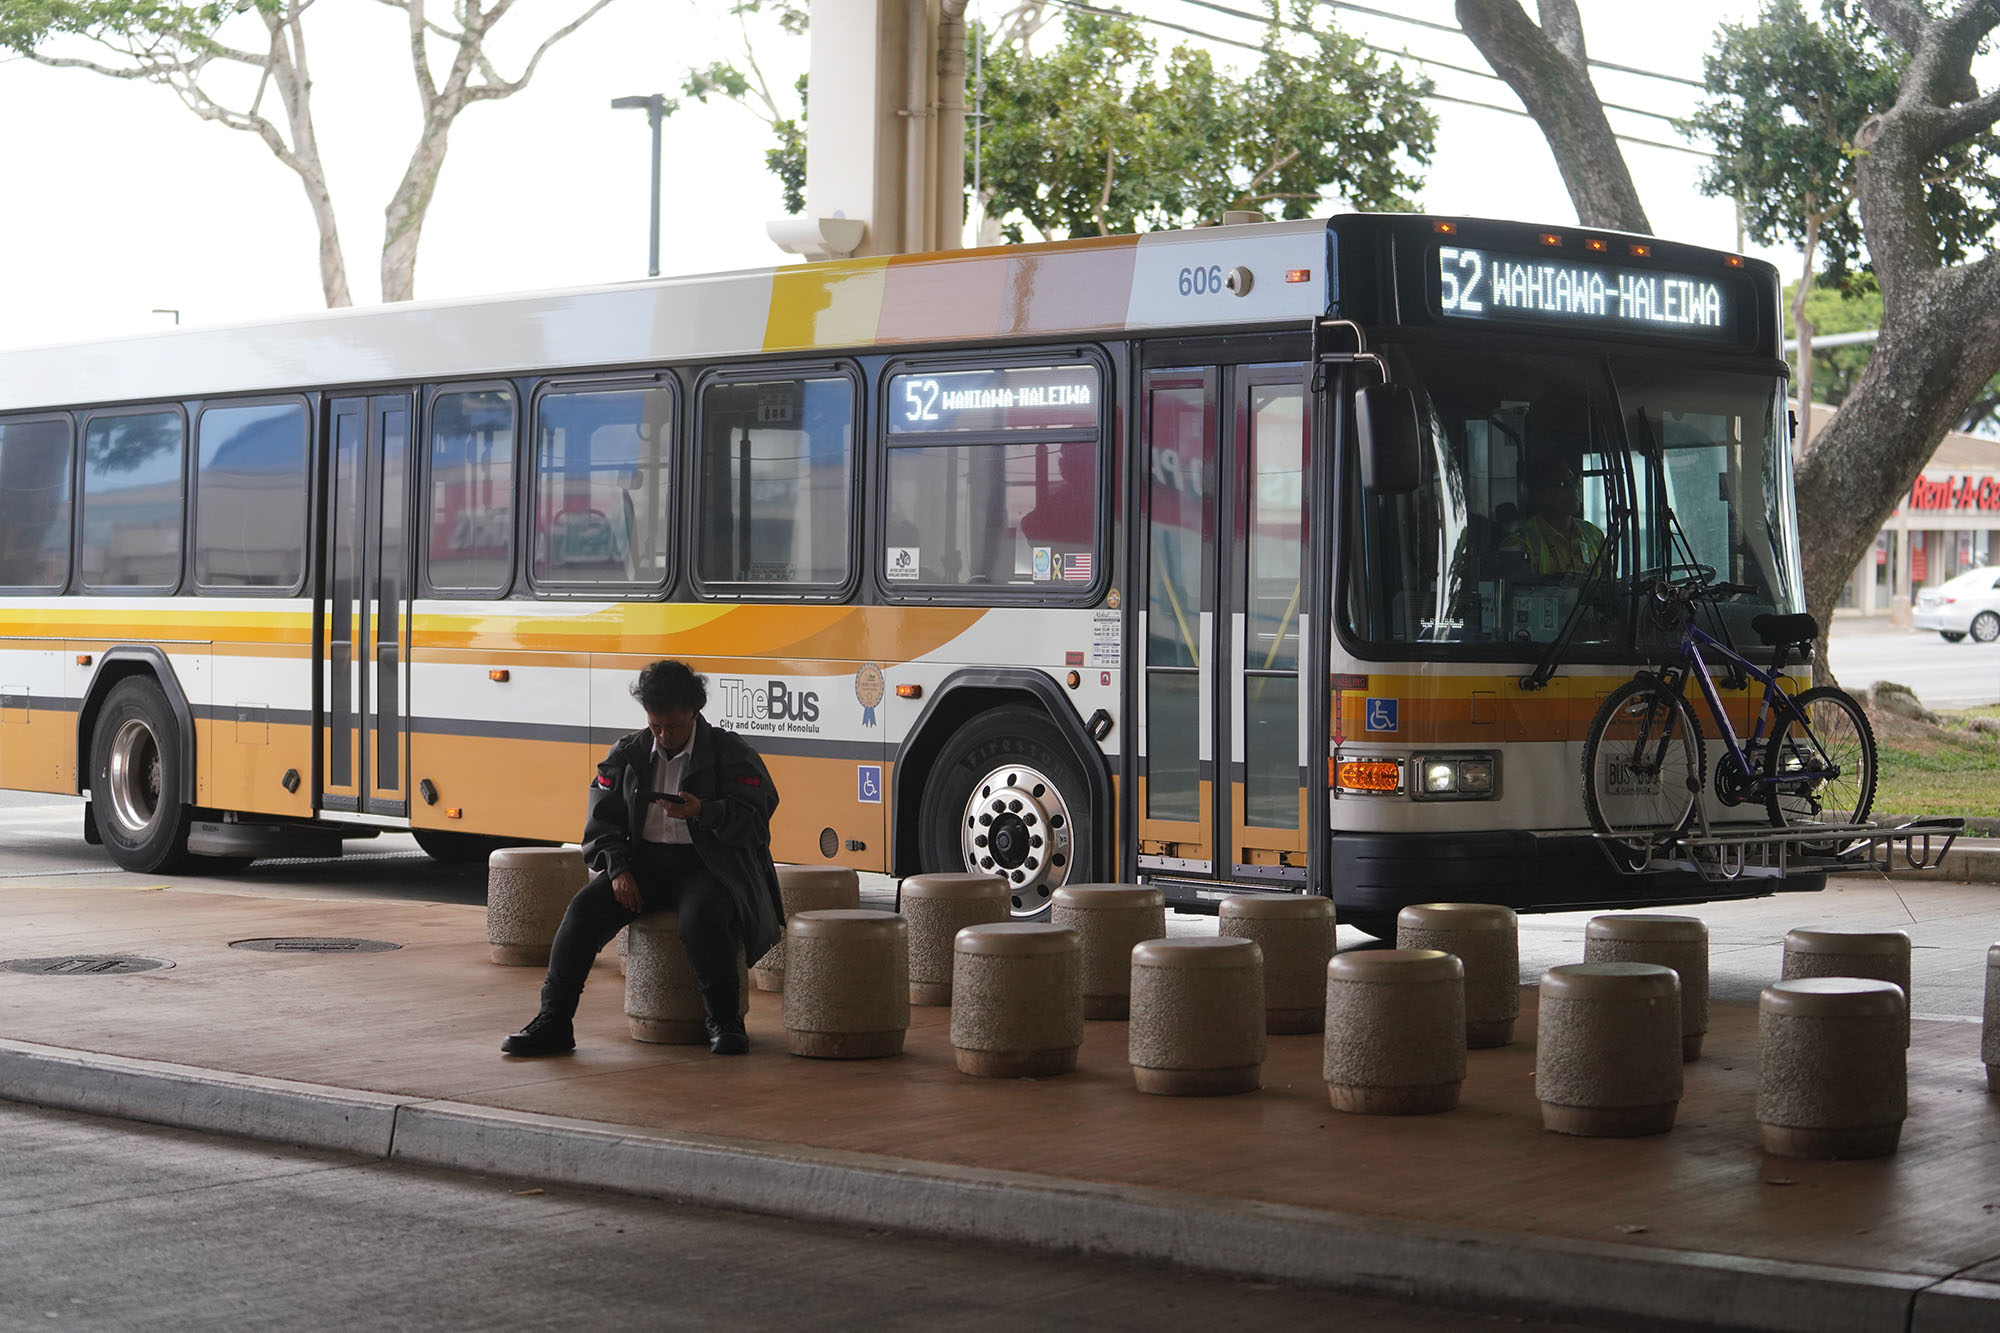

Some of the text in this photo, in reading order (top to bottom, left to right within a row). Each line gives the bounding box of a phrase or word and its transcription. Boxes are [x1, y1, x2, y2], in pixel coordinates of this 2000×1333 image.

[1178, 264, 1222, 297] 606
[1440, 246, 1721, 327] 52 WAHIAWA-HALEIWA
[906, 380, 1091, 421] 52 WAHIAWA-HALEIWA
[719, 678, 820, 722] TheBus
[719, 719, 820, 733] City and County of Honolulu
